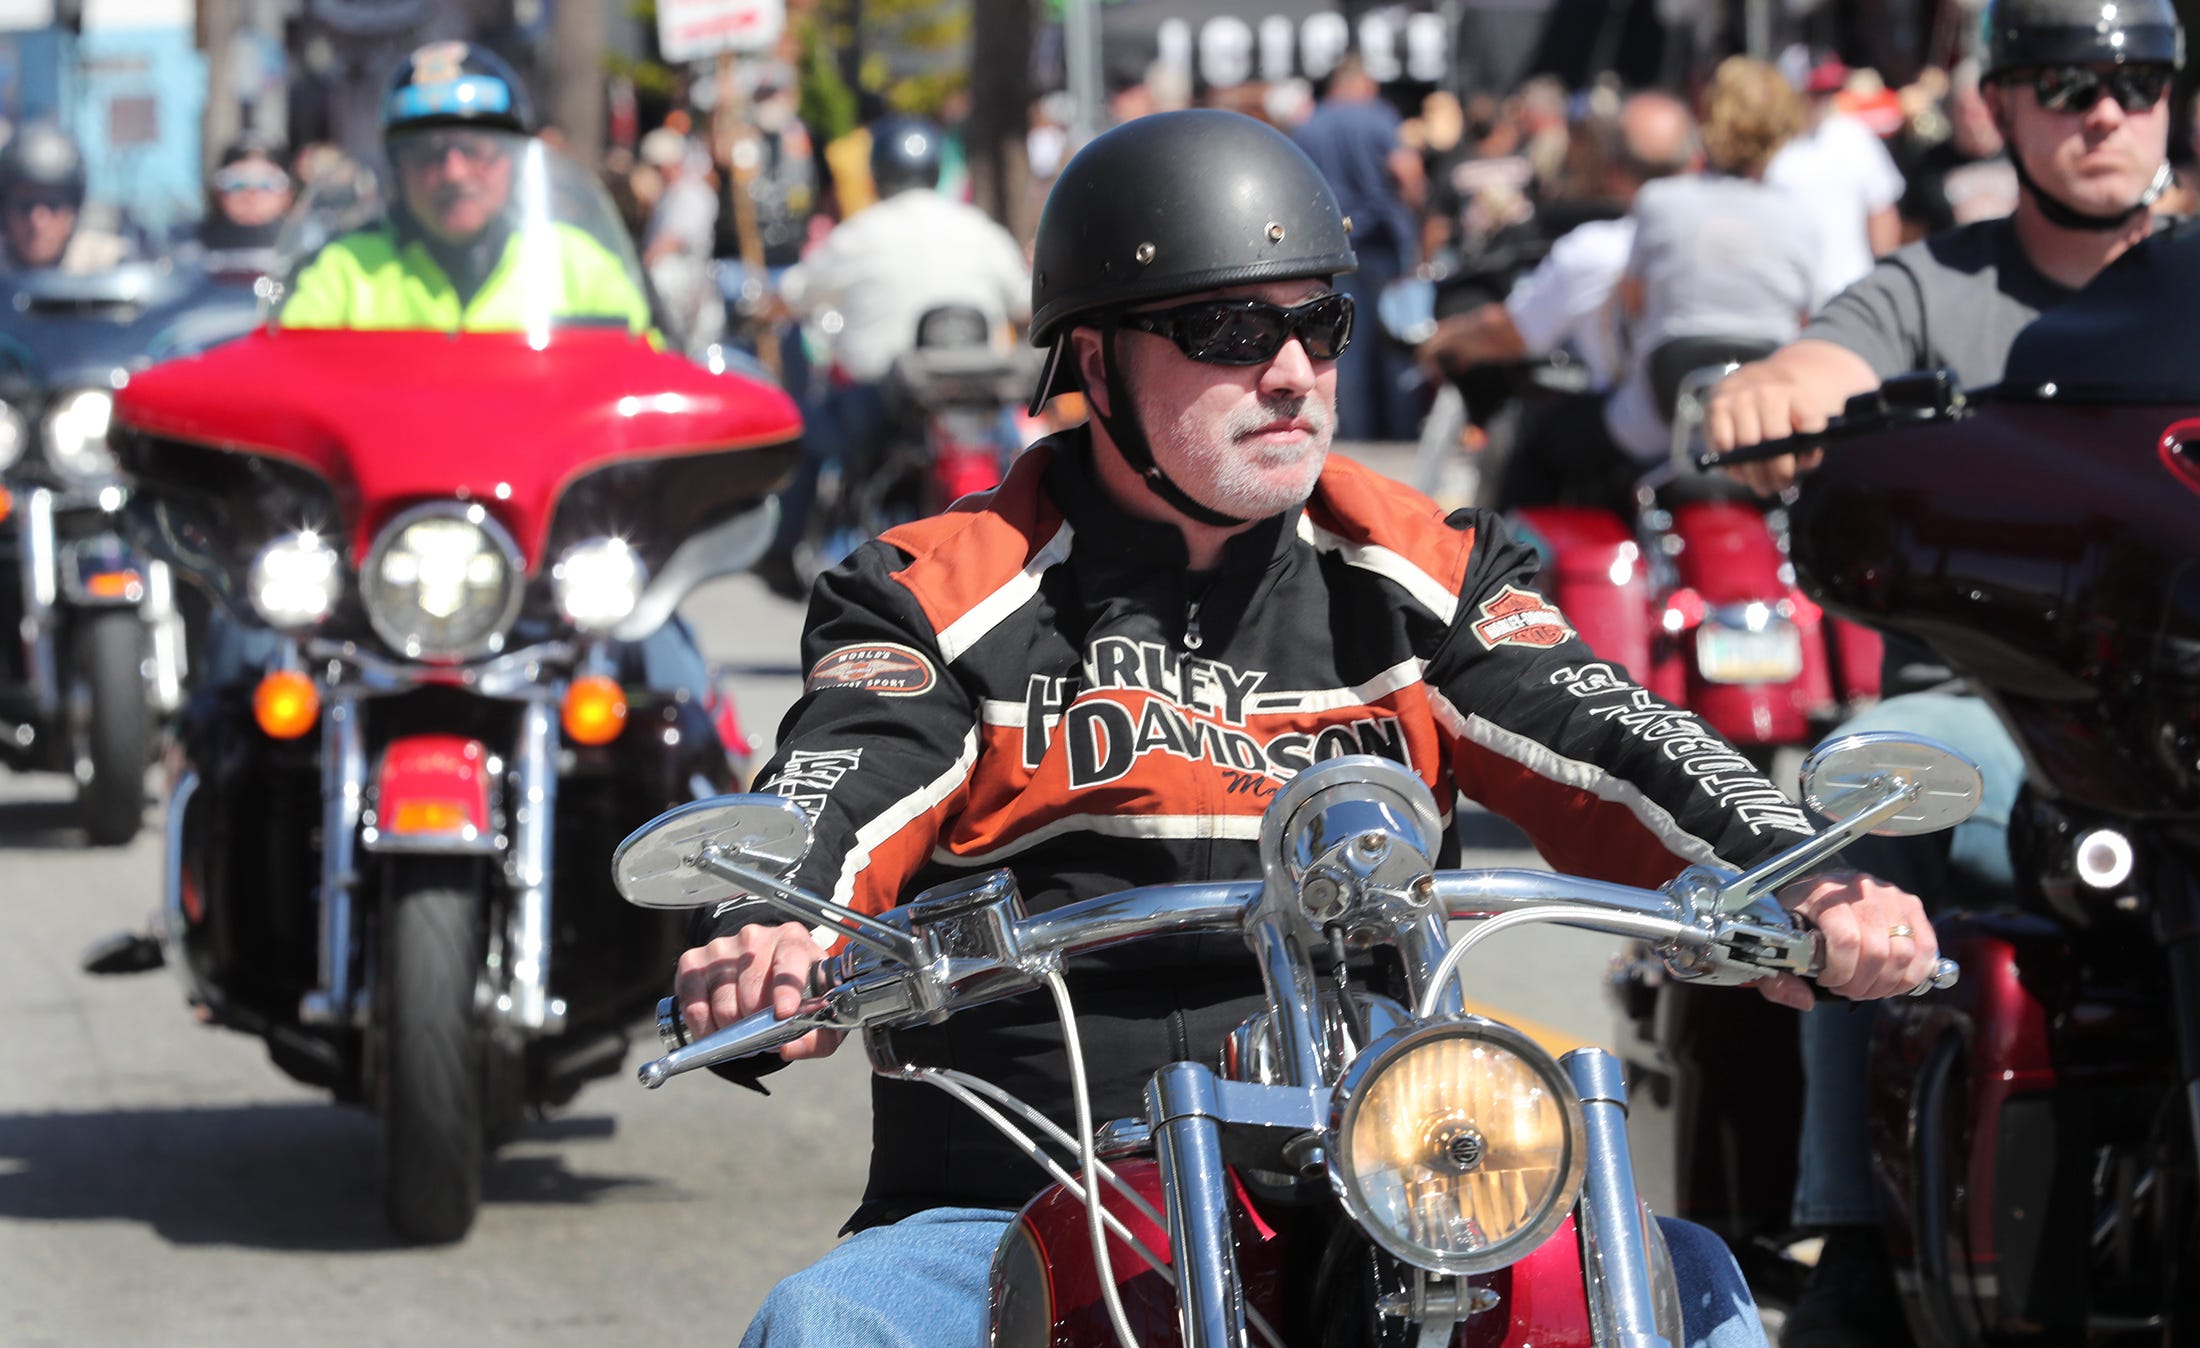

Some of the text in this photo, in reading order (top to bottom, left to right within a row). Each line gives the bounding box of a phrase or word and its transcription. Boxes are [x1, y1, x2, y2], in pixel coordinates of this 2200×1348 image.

[838, 650, 891, 663] WORLD'S
[866, 679, 906, 688] SPORT
[1022, 636, 1304, 769] HRLEY-
[1064, 698, 1413, 790] DAVIDSON
